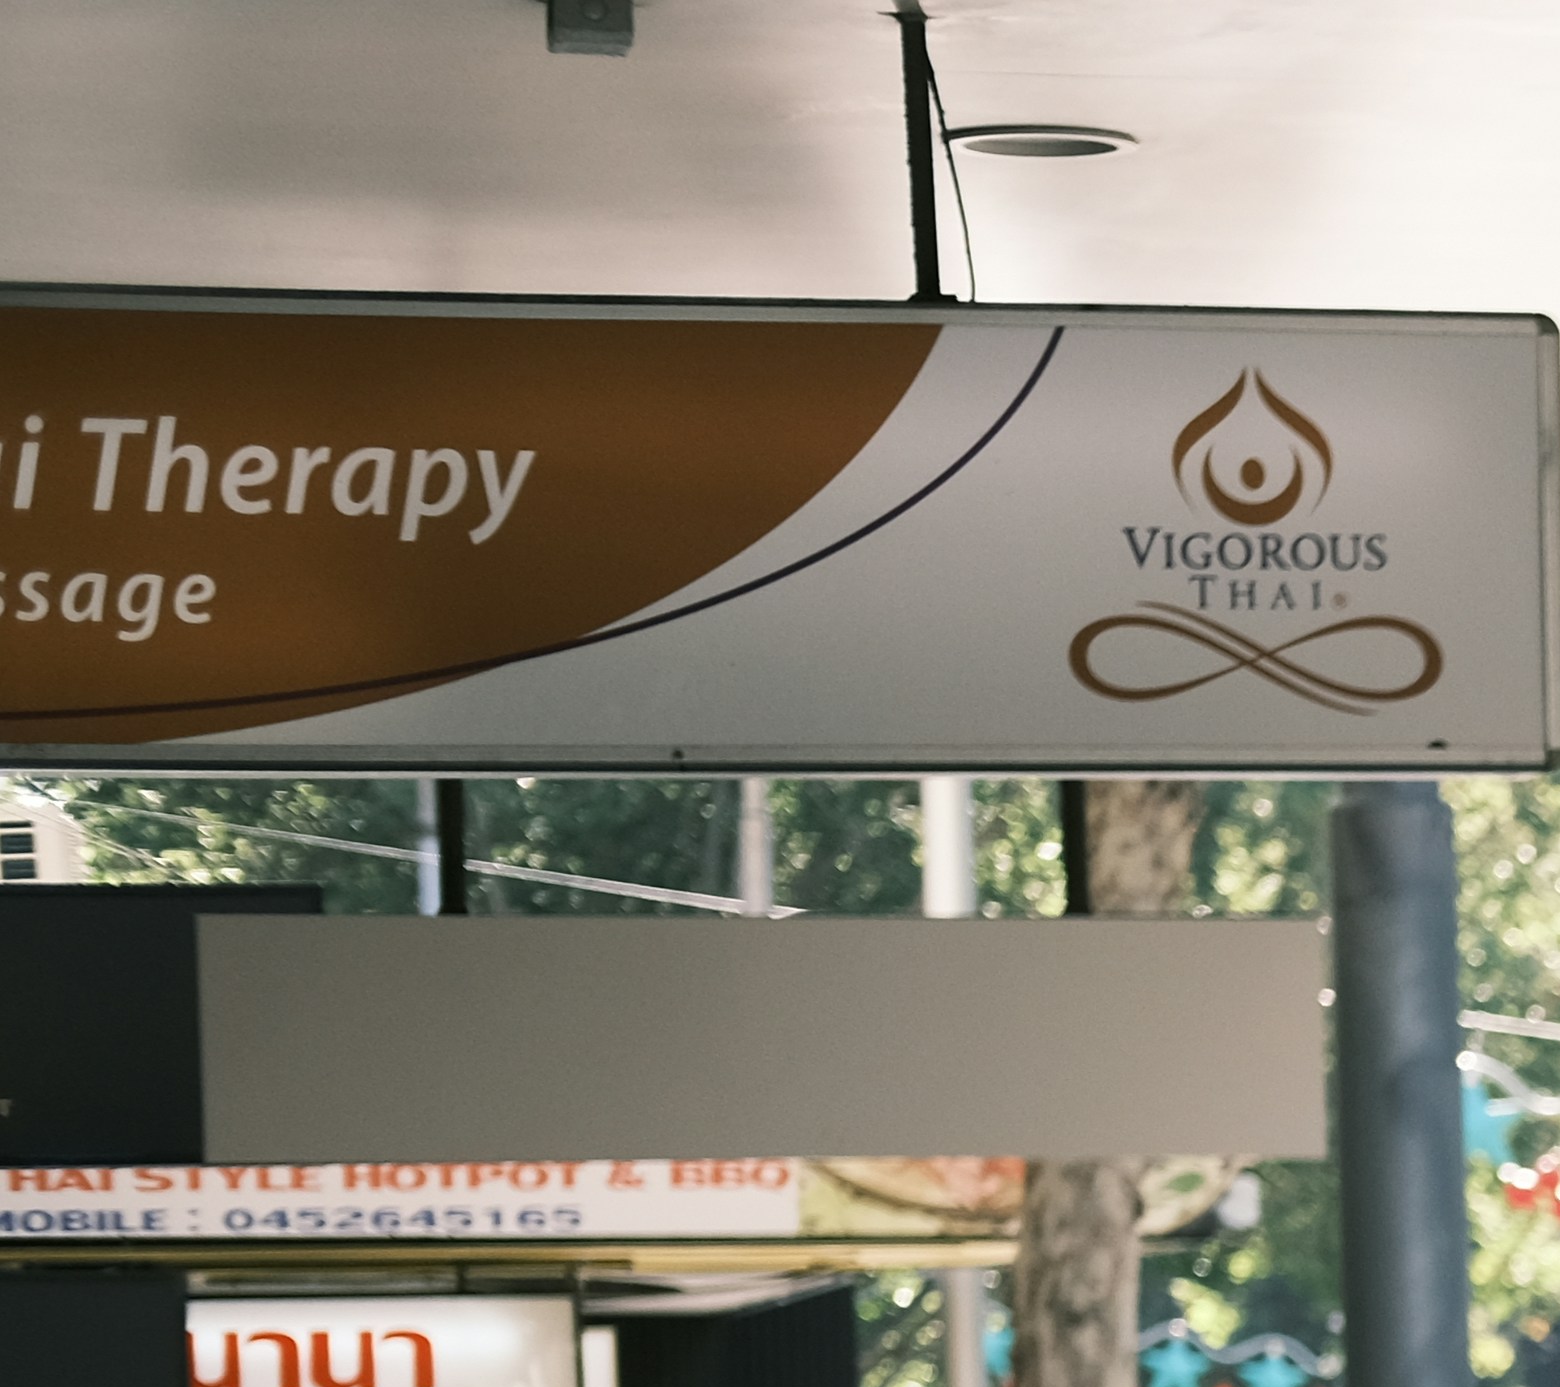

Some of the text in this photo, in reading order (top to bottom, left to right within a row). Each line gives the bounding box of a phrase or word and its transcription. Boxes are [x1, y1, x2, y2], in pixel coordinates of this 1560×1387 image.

[79, 416, 537, 545] Therapy
[1122, 524, 1389, 572] VIGOROUS
[0, 570, 216, 643] sage
[1189, 575, 1324, 612] THAI
